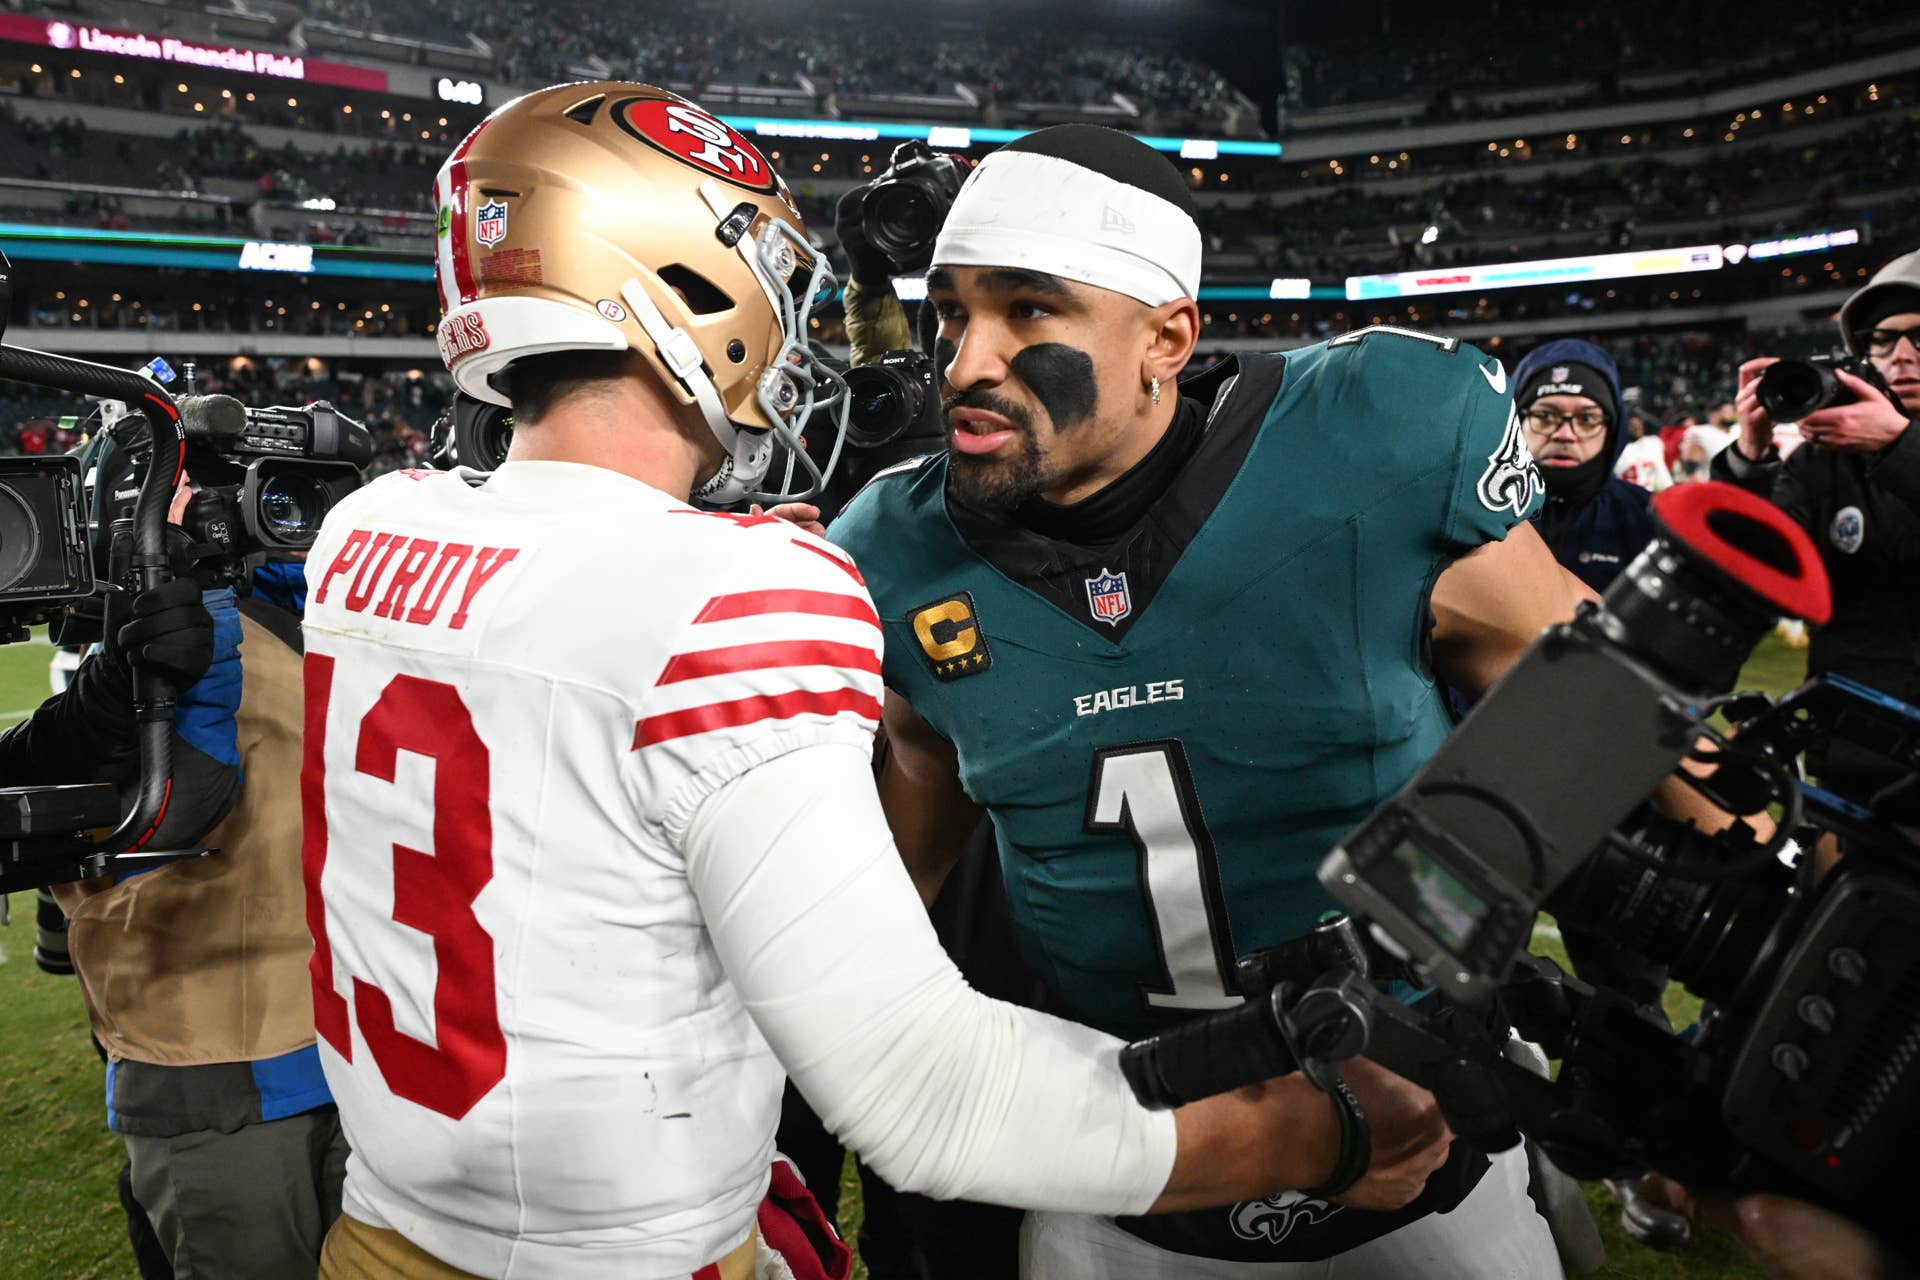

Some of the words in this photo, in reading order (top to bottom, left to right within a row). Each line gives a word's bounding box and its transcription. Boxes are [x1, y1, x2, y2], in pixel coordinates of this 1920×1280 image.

[78, 26, 161, 59] Lincoln
[161, 38, 255, 73] Financial
[255, 52, 304, 80] Field
[480, 220, 503, 240] NFL
[604, 302, 620, 319] 13
[315, 529, 521, 630] PURDY
[913, 600, 977, 661] C
[1095, 597, 1125, 617] NFL
[1073, 679, 1185, 717] EAGLES
[300, 652, 508, 1121] 13
[1087, 740, 1246, 1012] 1
